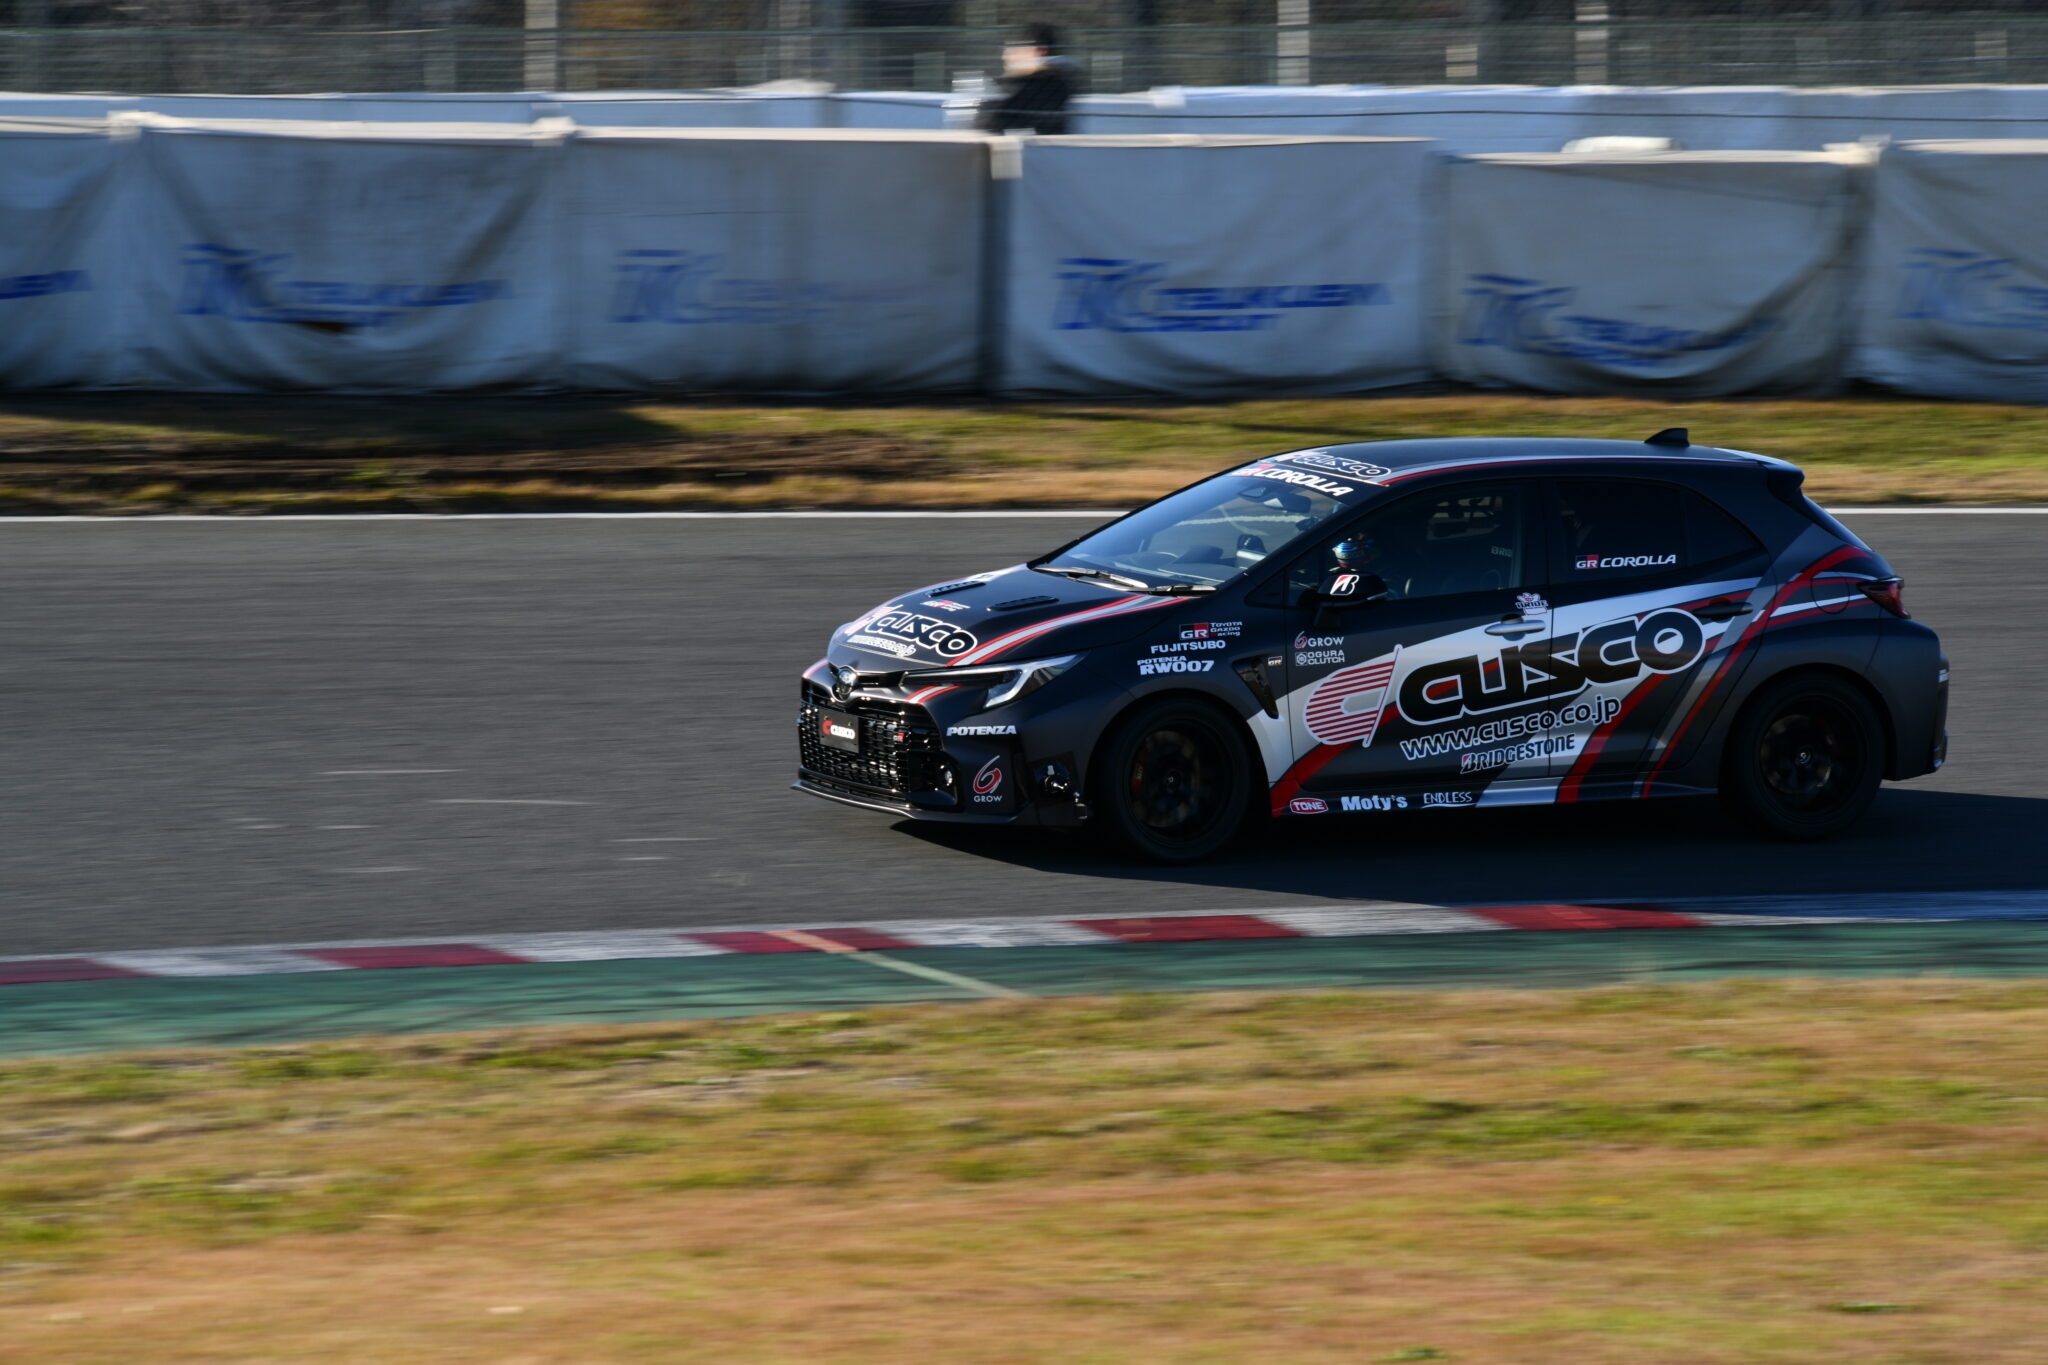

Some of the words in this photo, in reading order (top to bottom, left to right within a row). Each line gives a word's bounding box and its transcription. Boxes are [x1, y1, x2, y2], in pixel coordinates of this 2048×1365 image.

[1256, 468, 1354, 497] COROLLA
[1575, 560, 1598, 568] GR
[1600, 554, 1677, 568] COROLLA
[865, 611, 978, 658] CUSCO
[1180, 629, 1208, 639] GR
[1151, 640, 1226, 654] FUJITSUBO
[1307, 636, 1345, 648] GROW
[1137, 655, 1187, 666] POTENZA
[1307, 649, 1345, 659] OGURA
[1307, 656, 1345, 666] CLUTCH
[1140, 660, 1215, 675] RW007
[1396, 608, 1707, 727] CUSCO
[946, 725, 1017, 737] POTENZA
[1400, 695, 1621, 760] www.cusco.co.jp
[1460, 733, 1576, 775] BRIDGESTONE
[973, 795, 1003, 803] GROW
[1341, 795, 1408, 811] Moty's
[1423, 791, 1473, 805] ENDLESS
[1294, 800, 1325, 812] TONE
